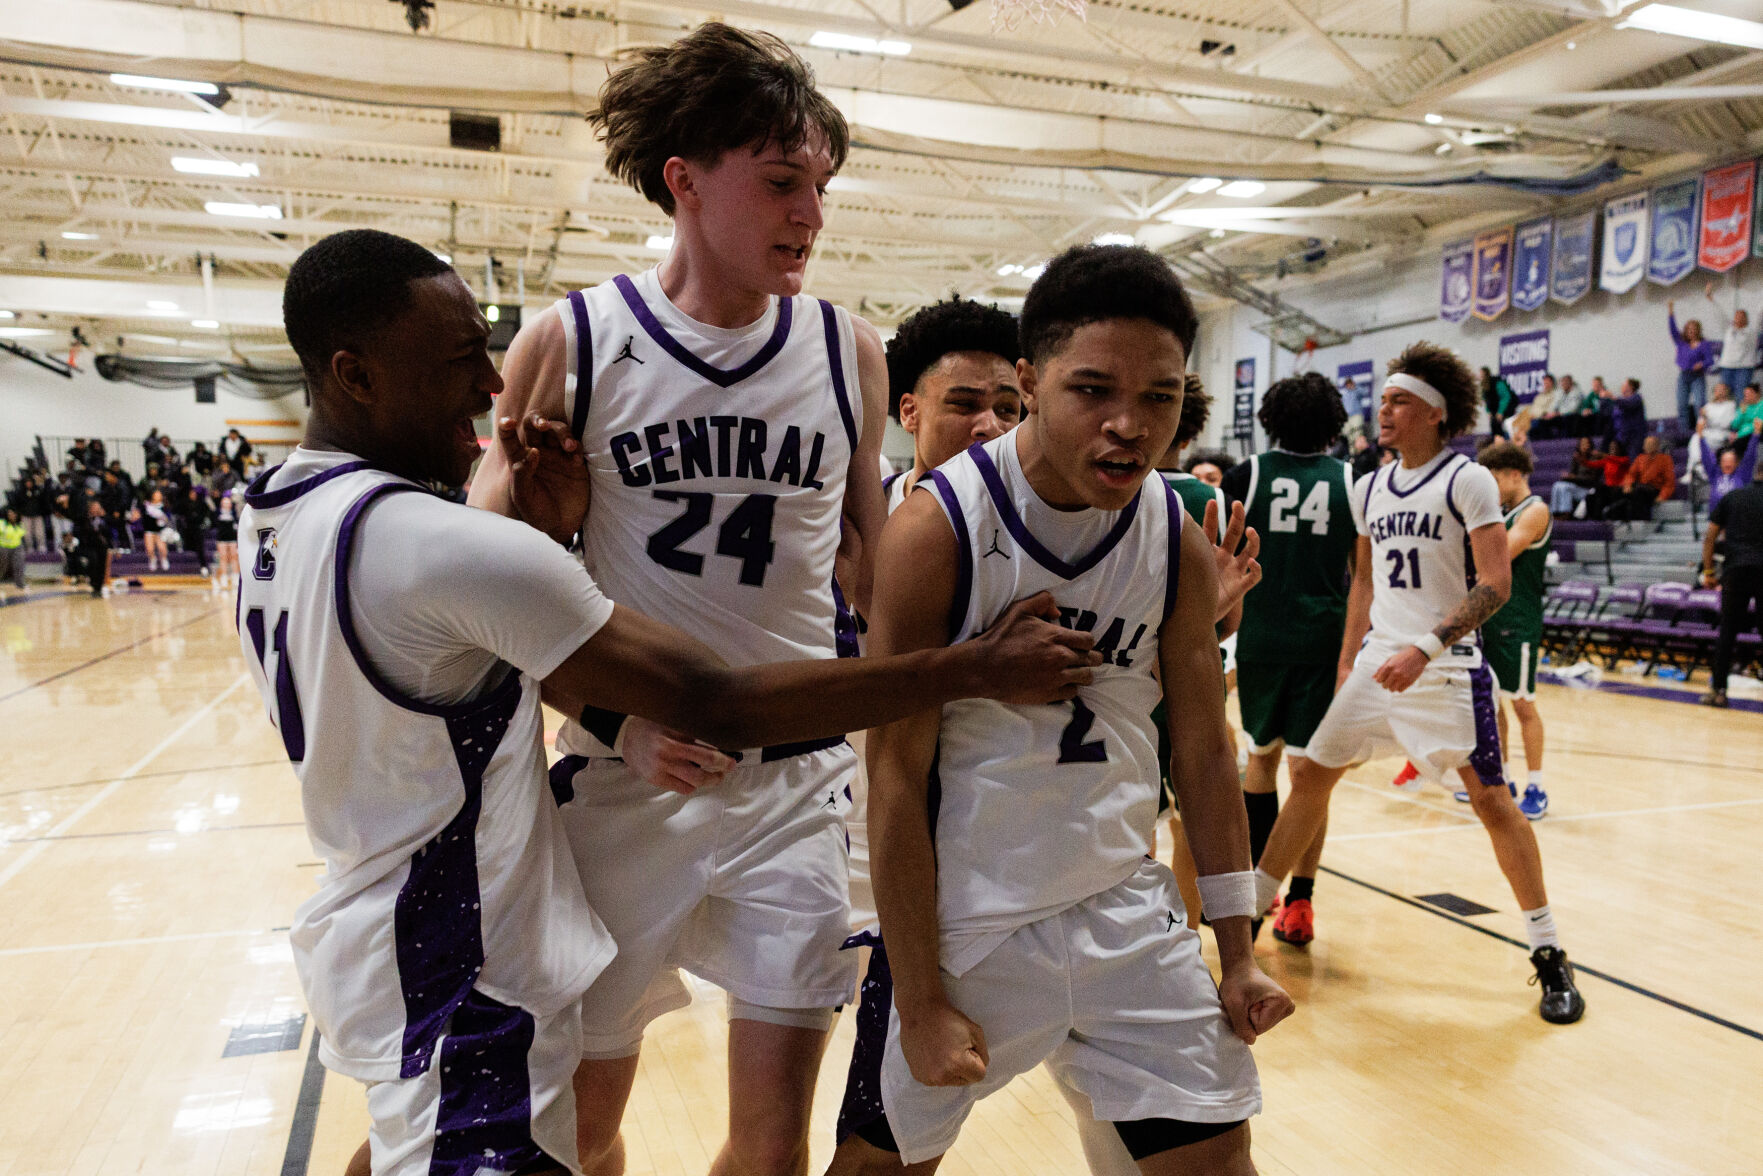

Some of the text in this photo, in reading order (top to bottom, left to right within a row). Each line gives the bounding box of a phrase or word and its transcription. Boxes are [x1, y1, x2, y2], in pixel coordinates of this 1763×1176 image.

[610, 415, 826, 491] CENTRAL
[646, 489, 779, 588] 24
[1269, 477, 1330, 536] 24
[1370, 511, 1442, 544] CENTRAL
[1386, 547, 1422, 589] 21
[1055, 695, 1109, 764] 2
